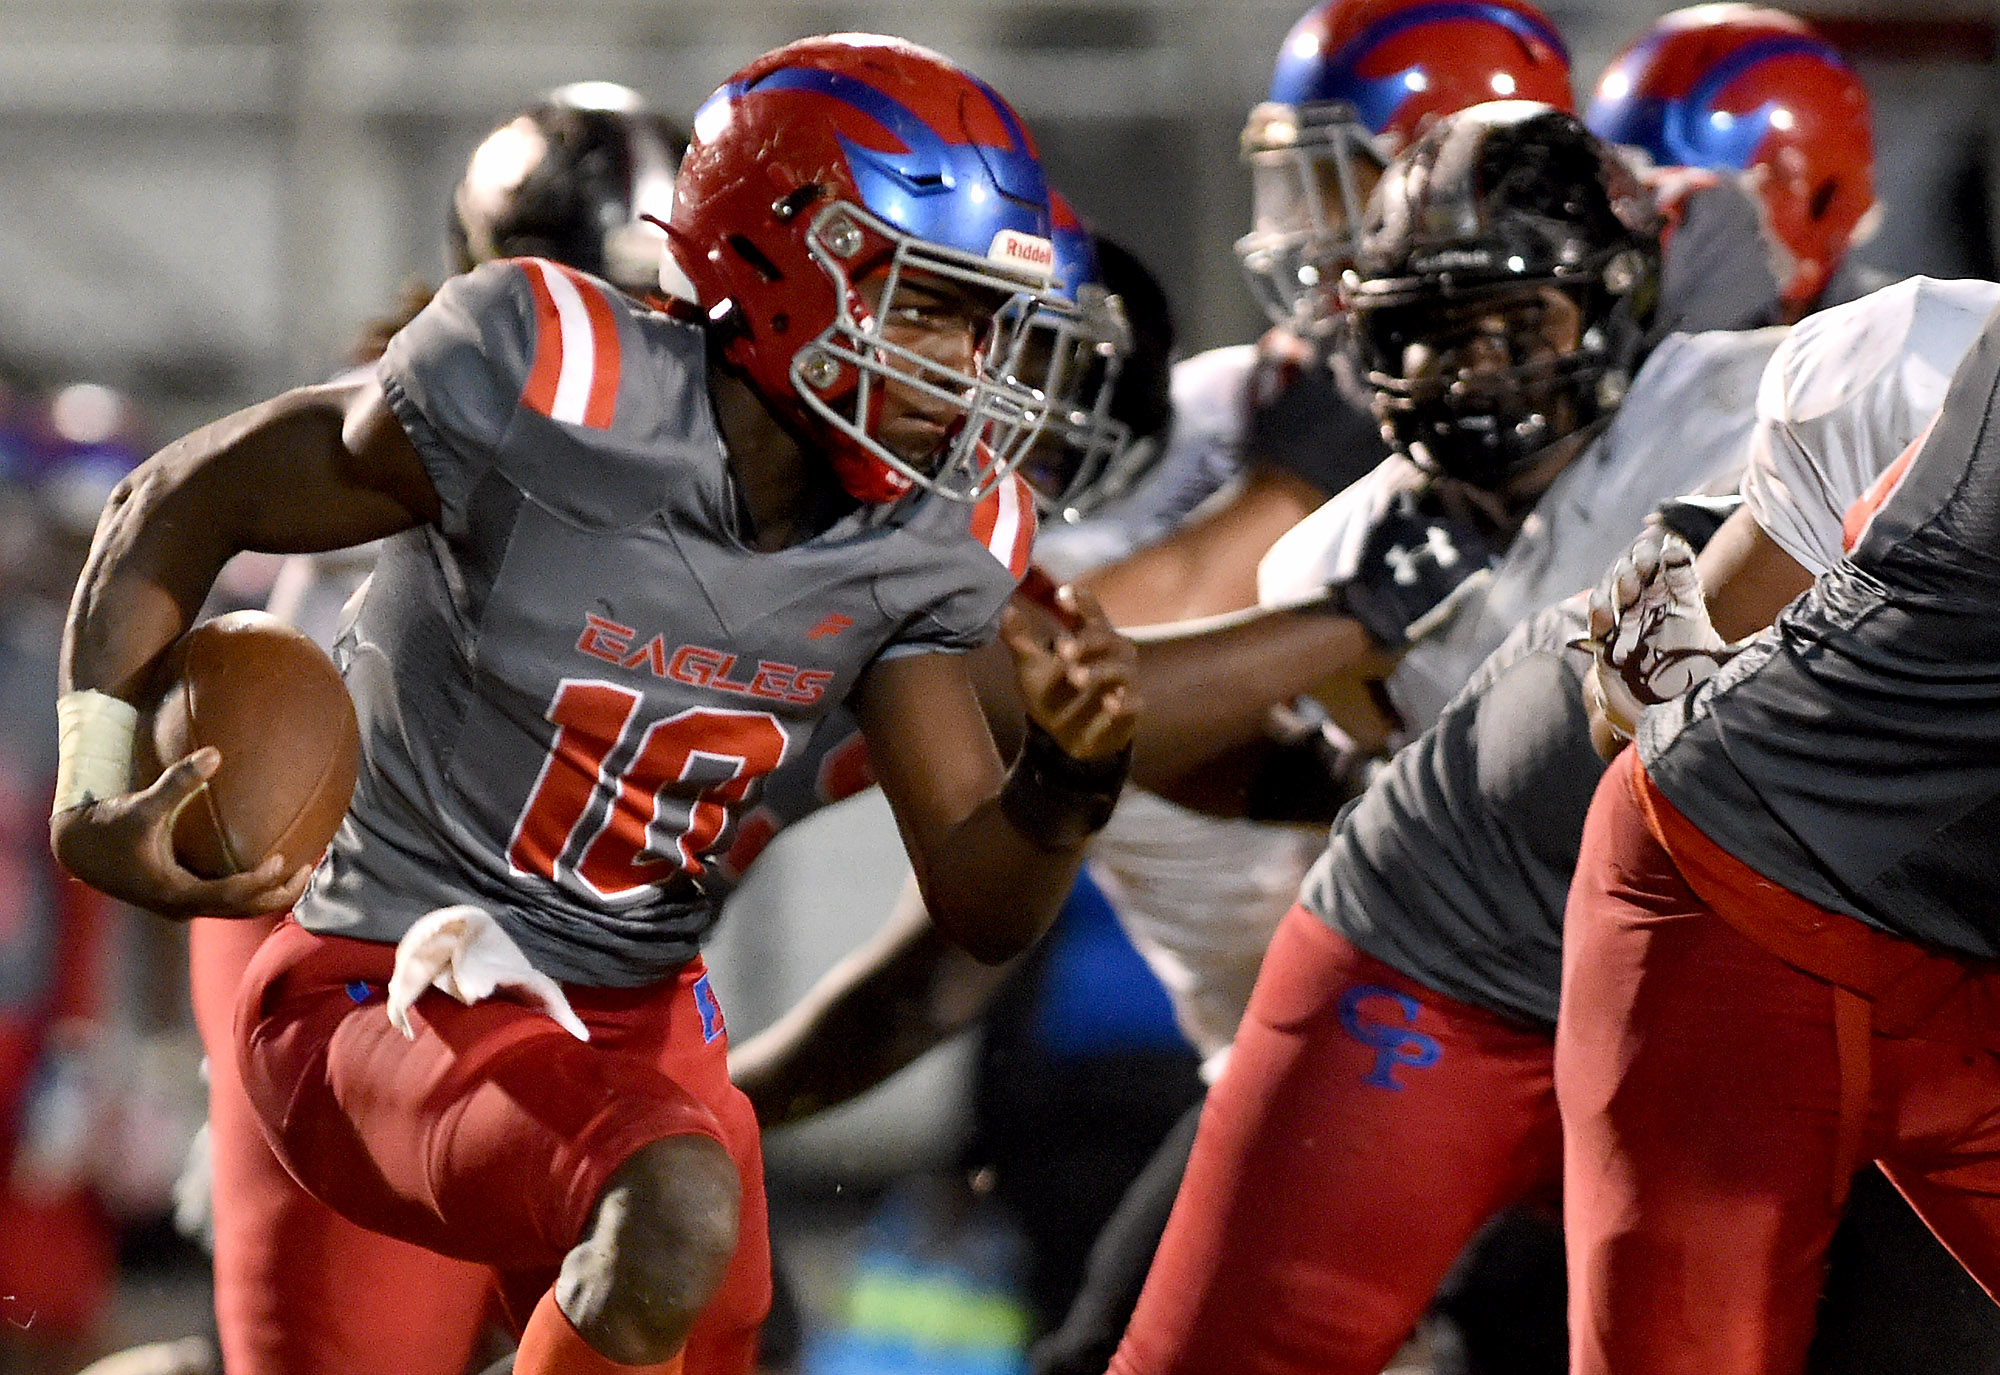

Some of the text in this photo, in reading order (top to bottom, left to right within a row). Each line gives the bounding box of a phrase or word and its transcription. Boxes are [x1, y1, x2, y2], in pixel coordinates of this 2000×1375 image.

[575, 611, 835, 706] EAGLES
[504, 677, 790, 901] 10
[1336, 984, 1442, 1092] CP
